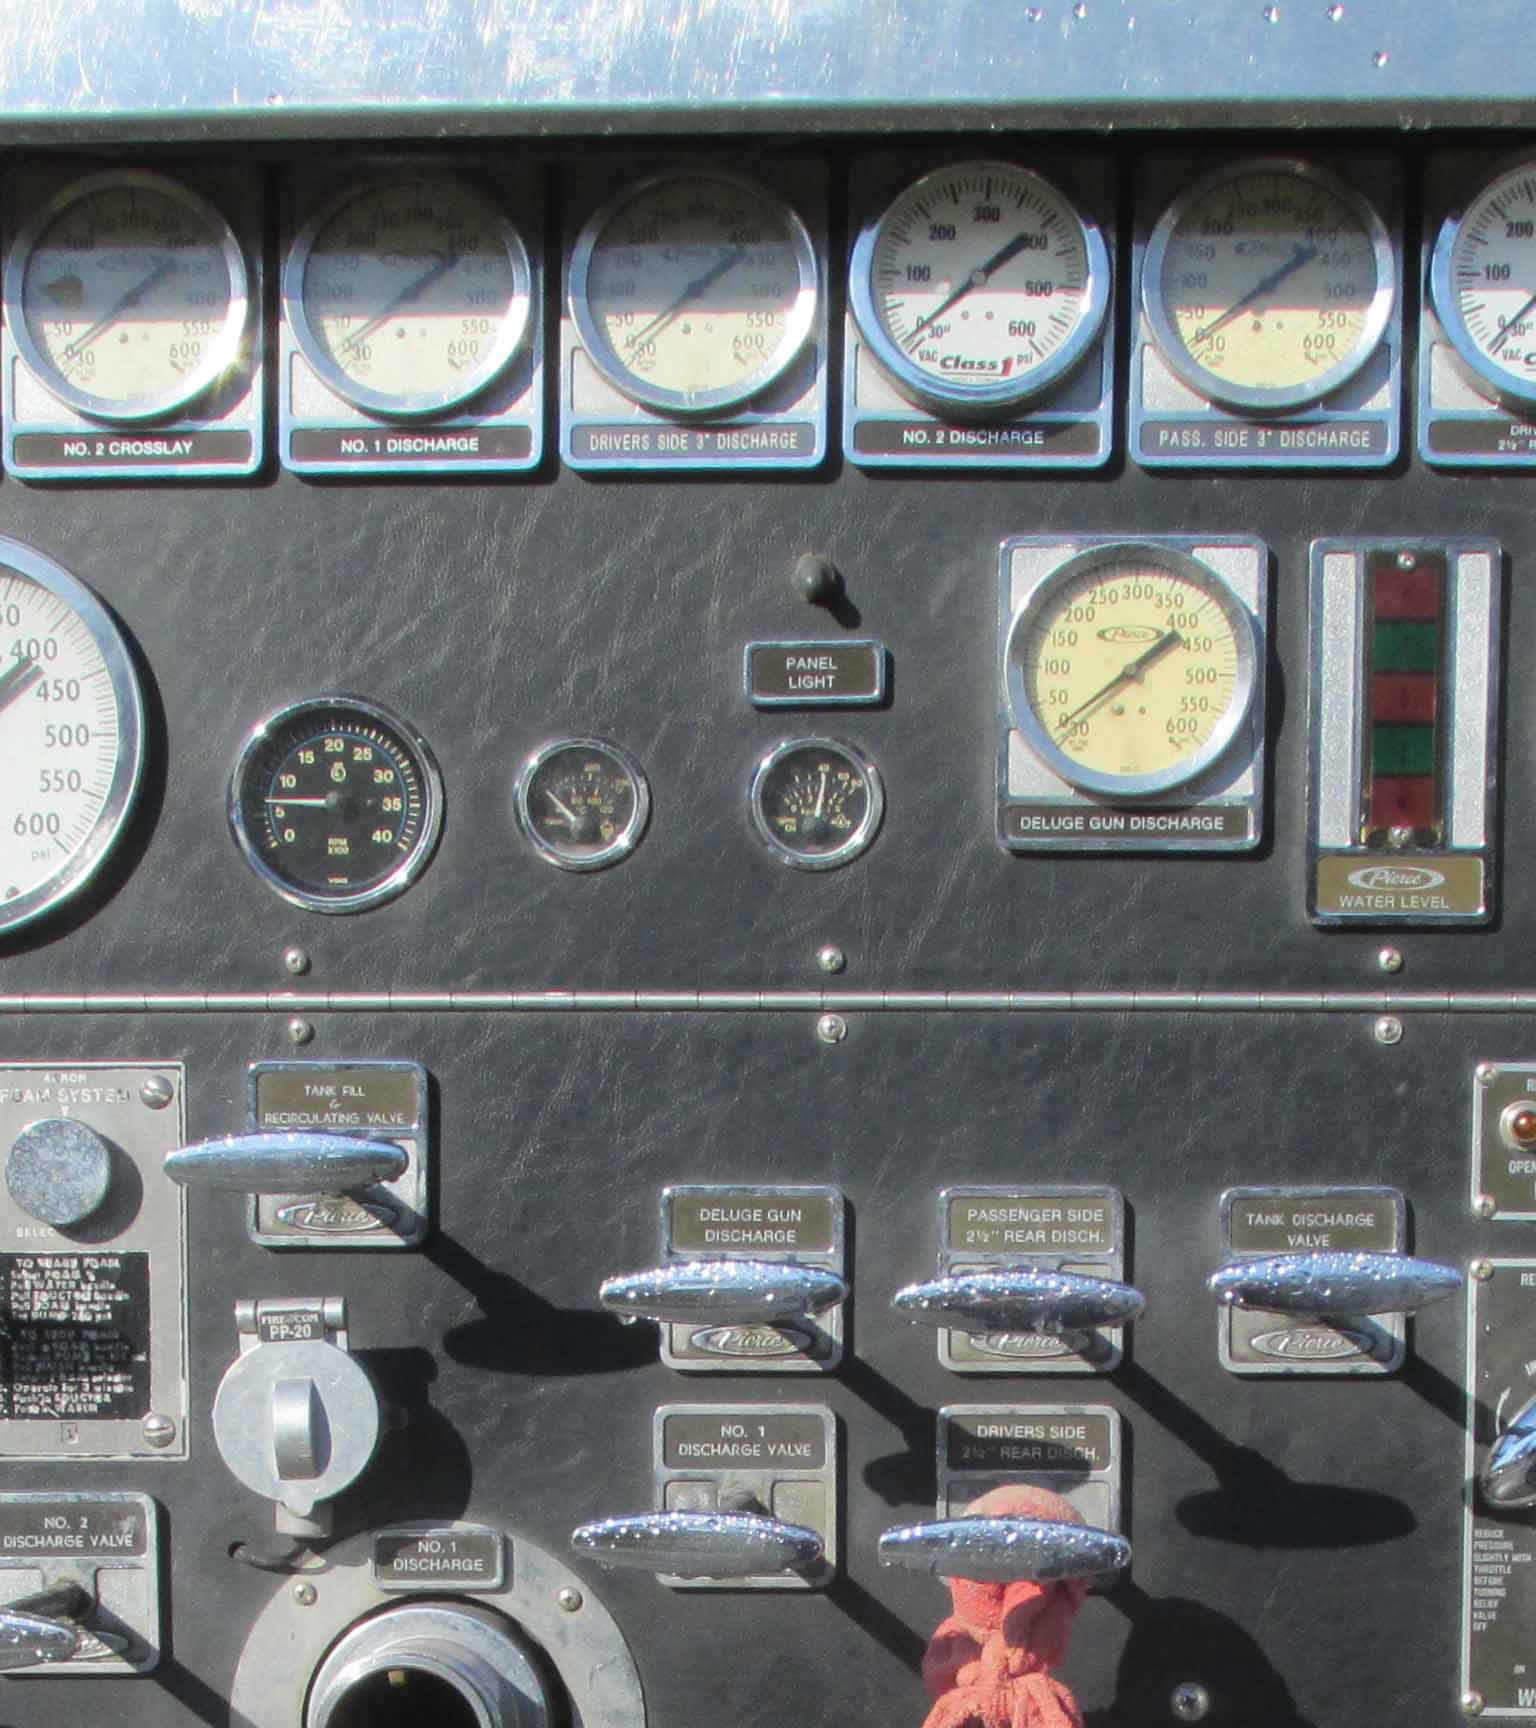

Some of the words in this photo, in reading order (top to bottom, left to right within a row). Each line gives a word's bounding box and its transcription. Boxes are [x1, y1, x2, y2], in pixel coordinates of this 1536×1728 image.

[341, 438, 369, 453] NO.
[374, 438, 381, 453] 1
[386, 438, 479, 453] DISCHARGE
[589, 433, 650, 451] DRIVERS
[655, 433, 689, 451] SIDE
[717, 432, 798, 451] DISCHARGE
[904, 431, 930, 446] NO.
[935, 431, 944, 446] 2
[950, 430, 1044, 446] DISCHARGE
[1160, 431, 1205, 448] PASS.
[1214, 431, 1248, 448] SIDE
[1278, 430, 1370, 449] DISCHARGE
[64, 441, 90, 457] NO.
[95, 441, 104, 457] 2
[108, 441, 192, 457] CROSSLAY
[1089, 588, 1119, 606] 250
[1122, 584, 1153, 601] 300
[1155, 590, 1184, 609] 350
[1064, 605, 1095, 622] 200
[1182, 635, 1212, 652] 450
[785, 656, 838, 670] PANEL
[789, 674, 836, 689] LIGHT
[1185, 667, 1217, 684] 500
[36, 679, 80, 702] 450
[1180, 696, 1209, 712] 550
[1165, 716, 1198, 734] 600
[44, 724, 89, 746] 500
[39, 770, 82, 792] 550
[14, 813, 60, 835] 600
[1020, 816, 1084, 831] DELUGE
[1090, 816, 1125, 830] GUN
[1130, 816, 1224, 831] DISCHARGE
[1339, 895, 1394, 908] WATER
[1401, 895, 1449, 909] LEVEL
[264, 1112, 360, 1124] RECIRCULATING
[367, 1112, 406, 1124] VALVE
[700, 1208, 761, 1223] DELUGE
[767, 1208, 802, 1223] GUN
[967, 1208, 1062, 1224] PASSENGER
[1067, 1209, 1103, 1224] SIDE
[1247, 1213, 1285, 1228] TANK
[1292, 1213, 1375, 1227] DISCHARGE
[705, 1228, 797, 1243] DISCHARGE
[1288, 1234, 1330, 1248] VALVE
[270, 1324, 312, 1339] PP-20
[976, 1424, 1044, 1439] DRIVERS
[1051, 1425, 1086, 1439] SIDE
[679, 1442, 762, 1457] DISCHARGE
[768, 1442, 812, 1457] VALVE
[3, 1534, 84, 1549] DISCHARGE
[90, 1533, 133, 1549] VALVE
[393, 1558, 483, 1572] DISCHARGE
[1474, 1553, 1509, 1562] SLIGHTLY
